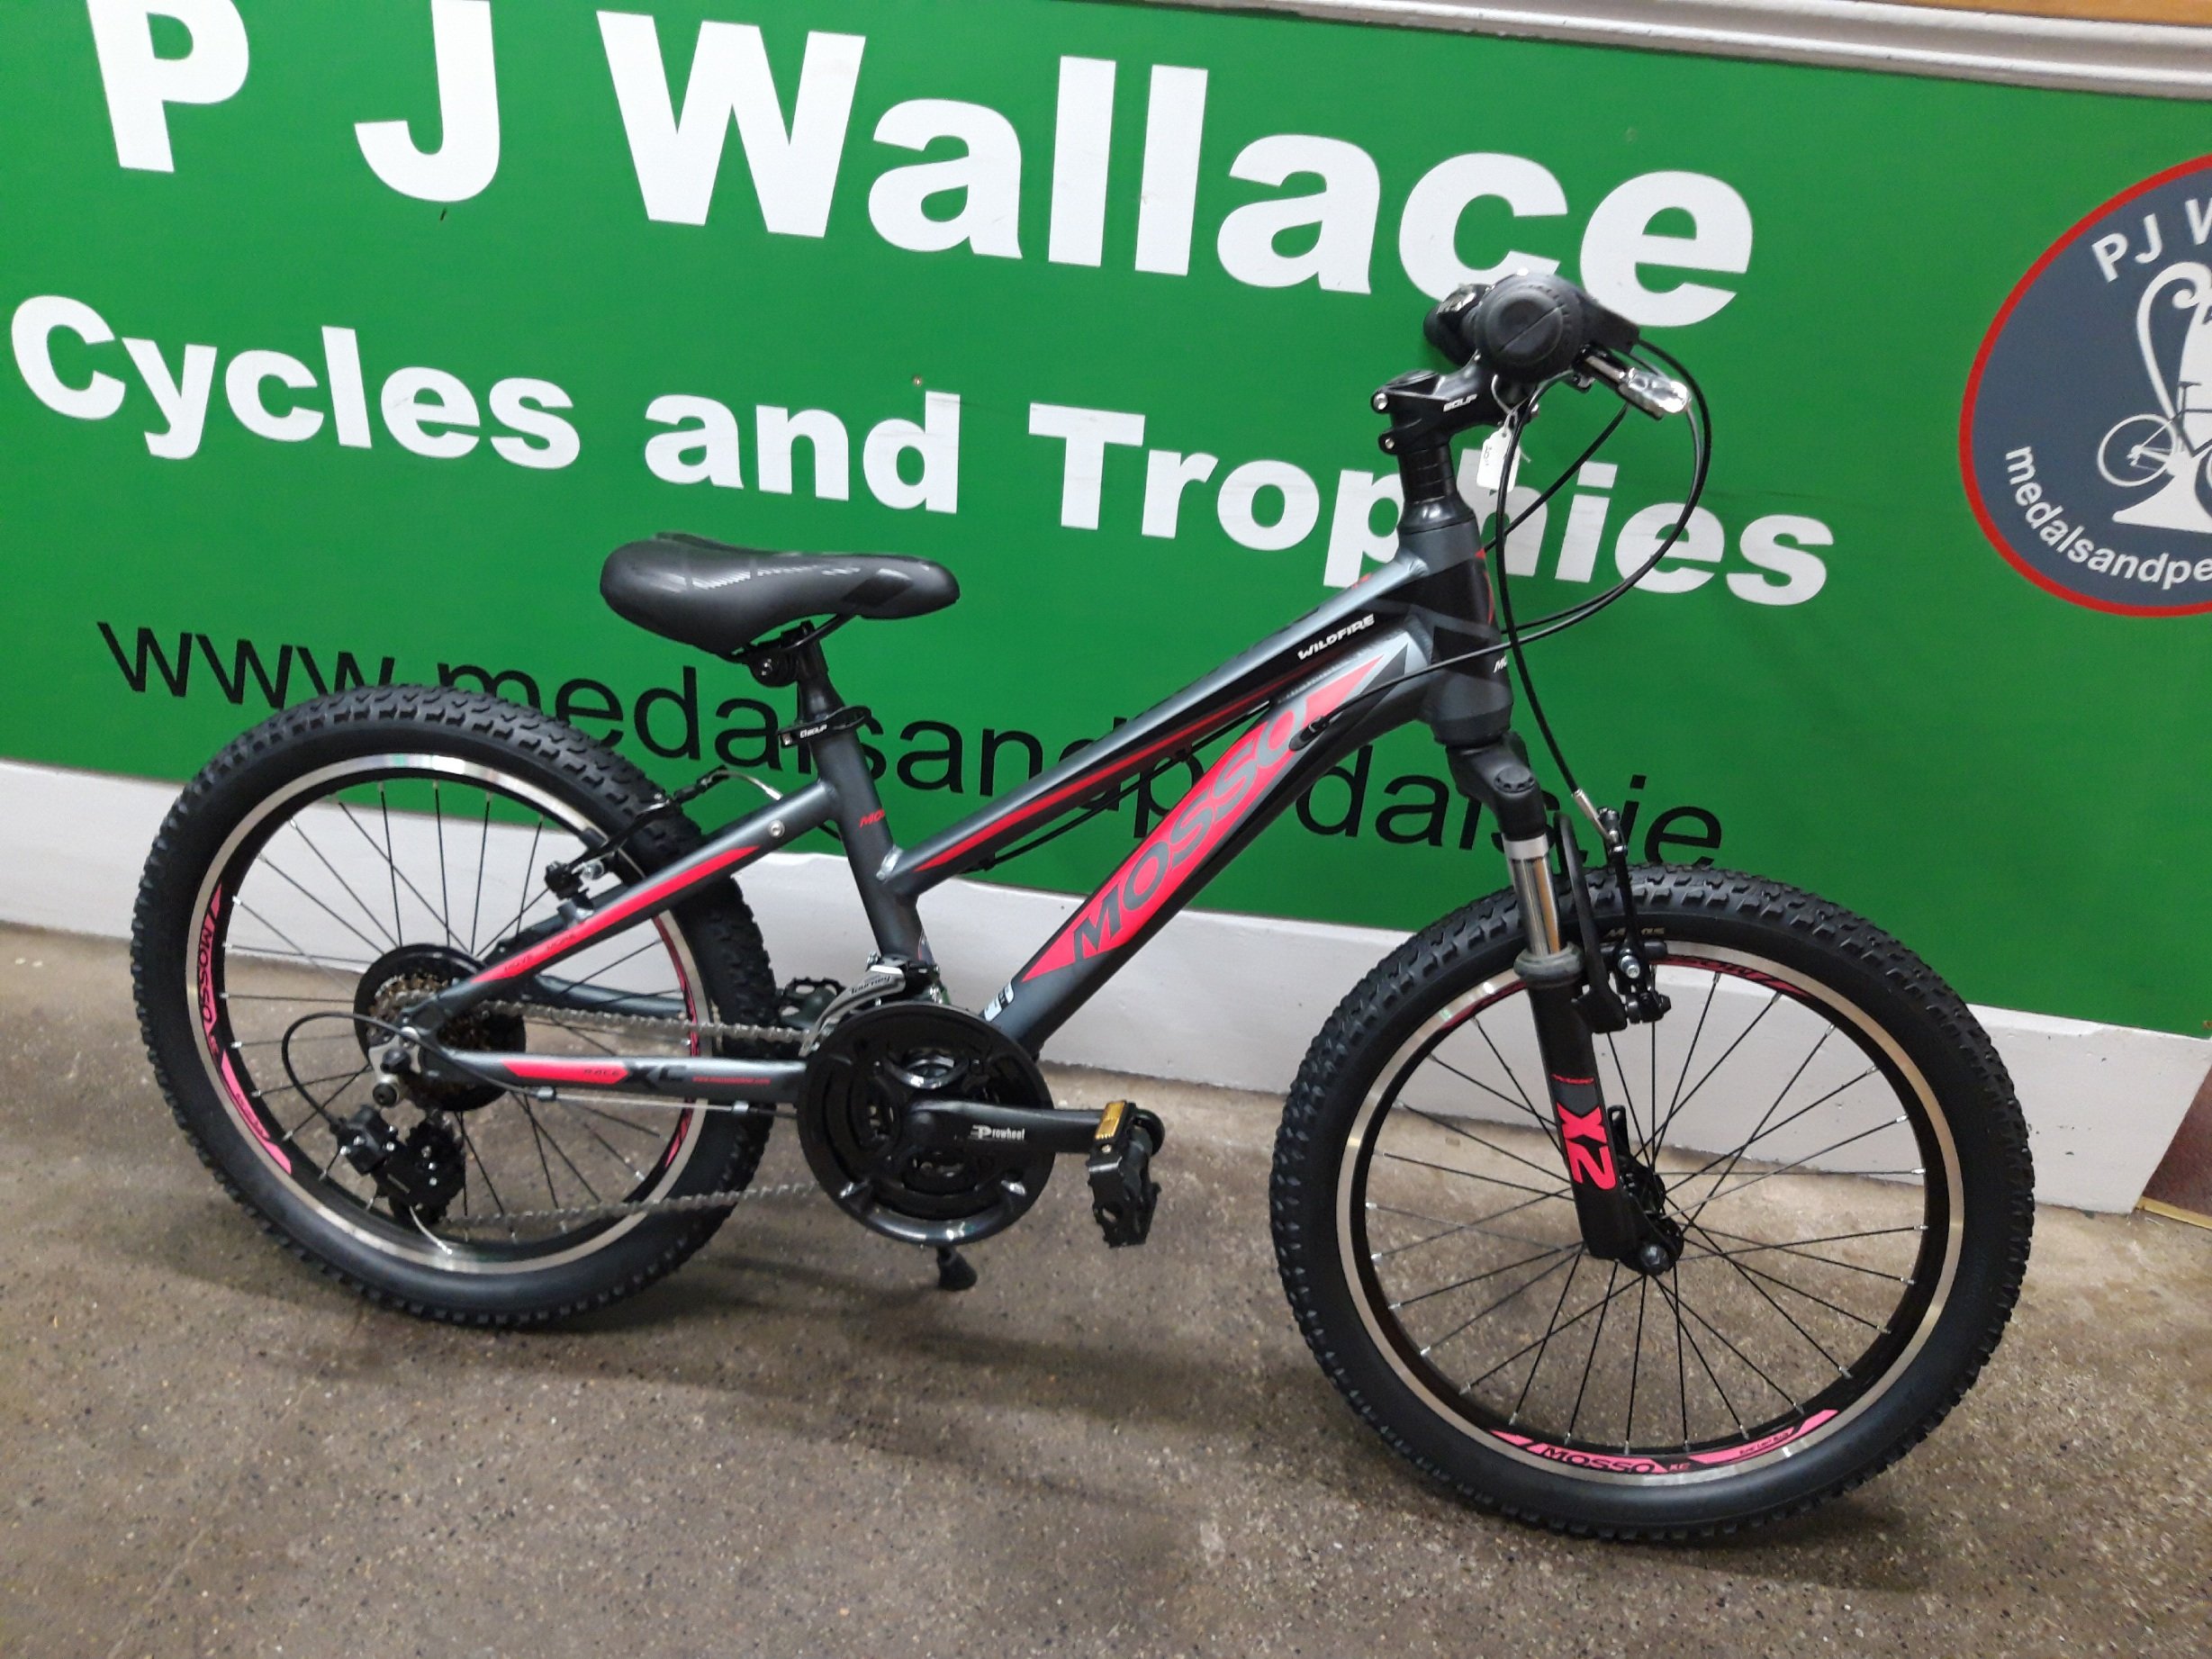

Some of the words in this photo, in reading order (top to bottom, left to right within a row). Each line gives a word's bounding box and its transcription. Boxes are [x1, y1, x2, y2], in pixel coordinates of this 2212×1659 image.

[86, 0, 249, 173] P
[354, 0, 501, 203] J
[596, 10, 1753, 327] Wallace
[11, 295, 580, 470] Cycles
[645, 391, 961, 514] and
[1028, 402, 1834, 605] Trophies
[1297, 613, 1376, 662] WILDFIRE
[1074, 704, 1302, 961] MOSSO
[1540, 1446, 1657, 1474] MOSSO
